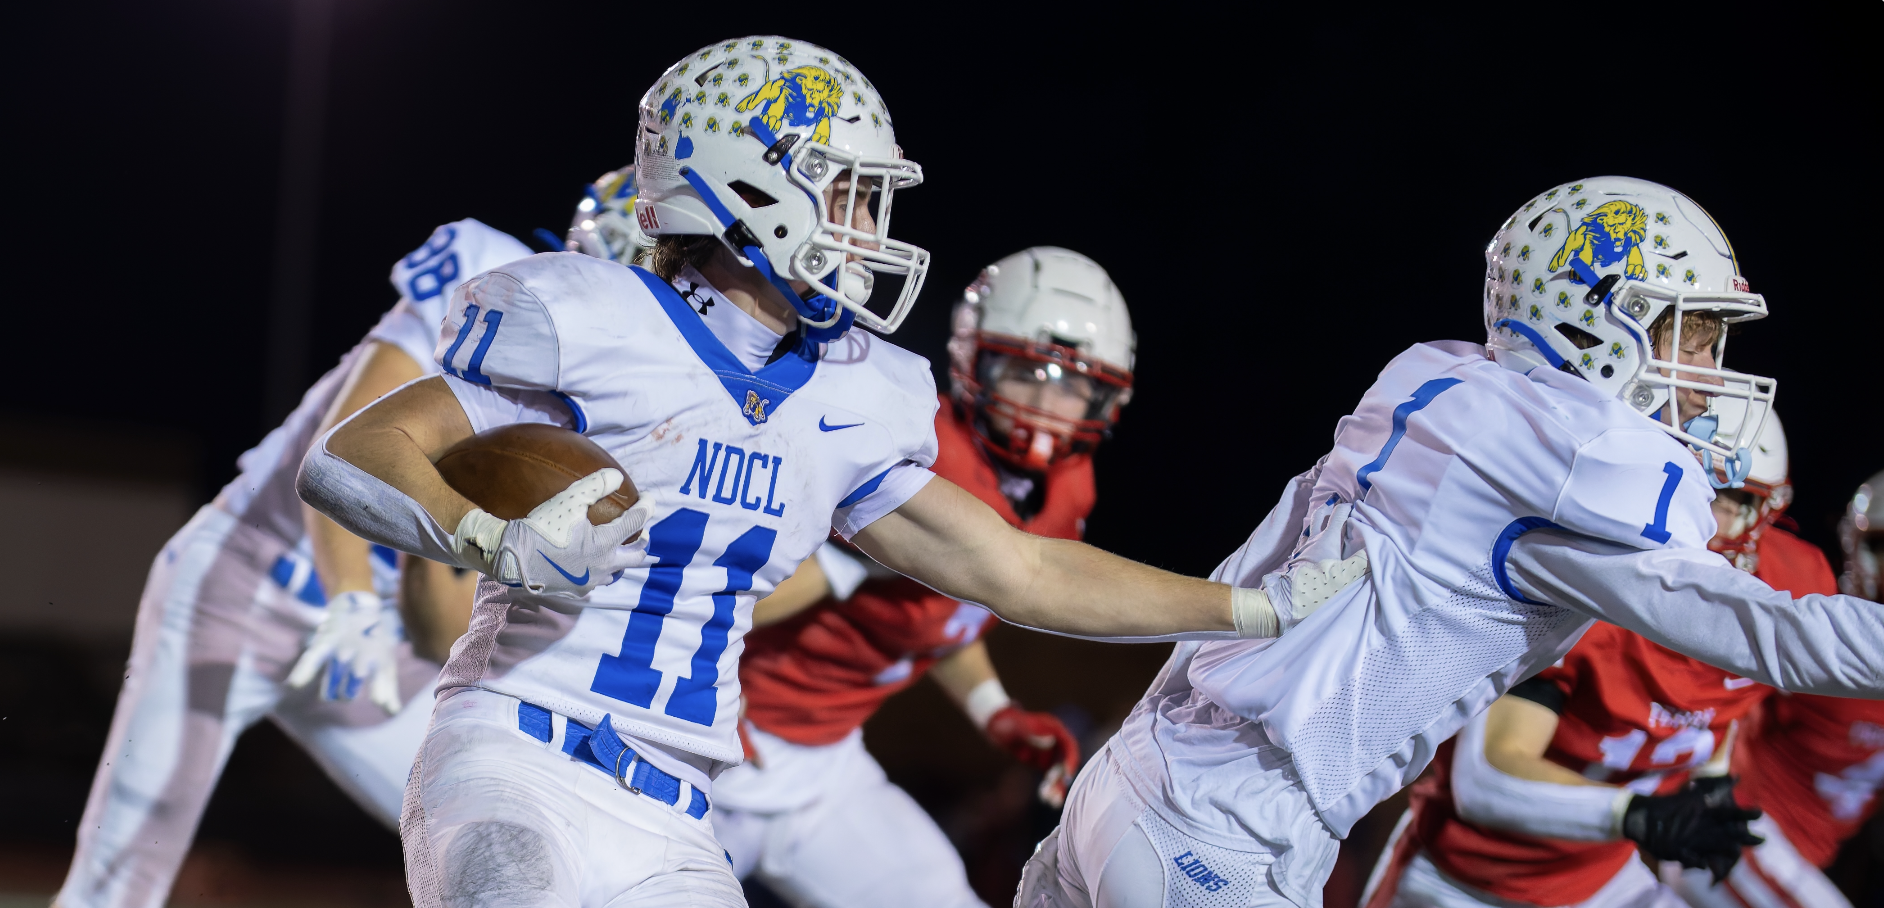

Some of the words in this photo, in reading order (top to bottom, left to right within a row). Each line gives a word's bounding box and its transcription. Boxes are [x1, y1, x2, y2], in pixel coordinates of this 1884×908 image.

[407, 226, 459, 301] 88
[442, 304, 503, 386] 11
[679, 438, 785, 517] NDCL
[1640, 461, 1683, 544] 1
[590, 507, 778, 727] 11
[1173, 850, 1229, 892] LIONS
